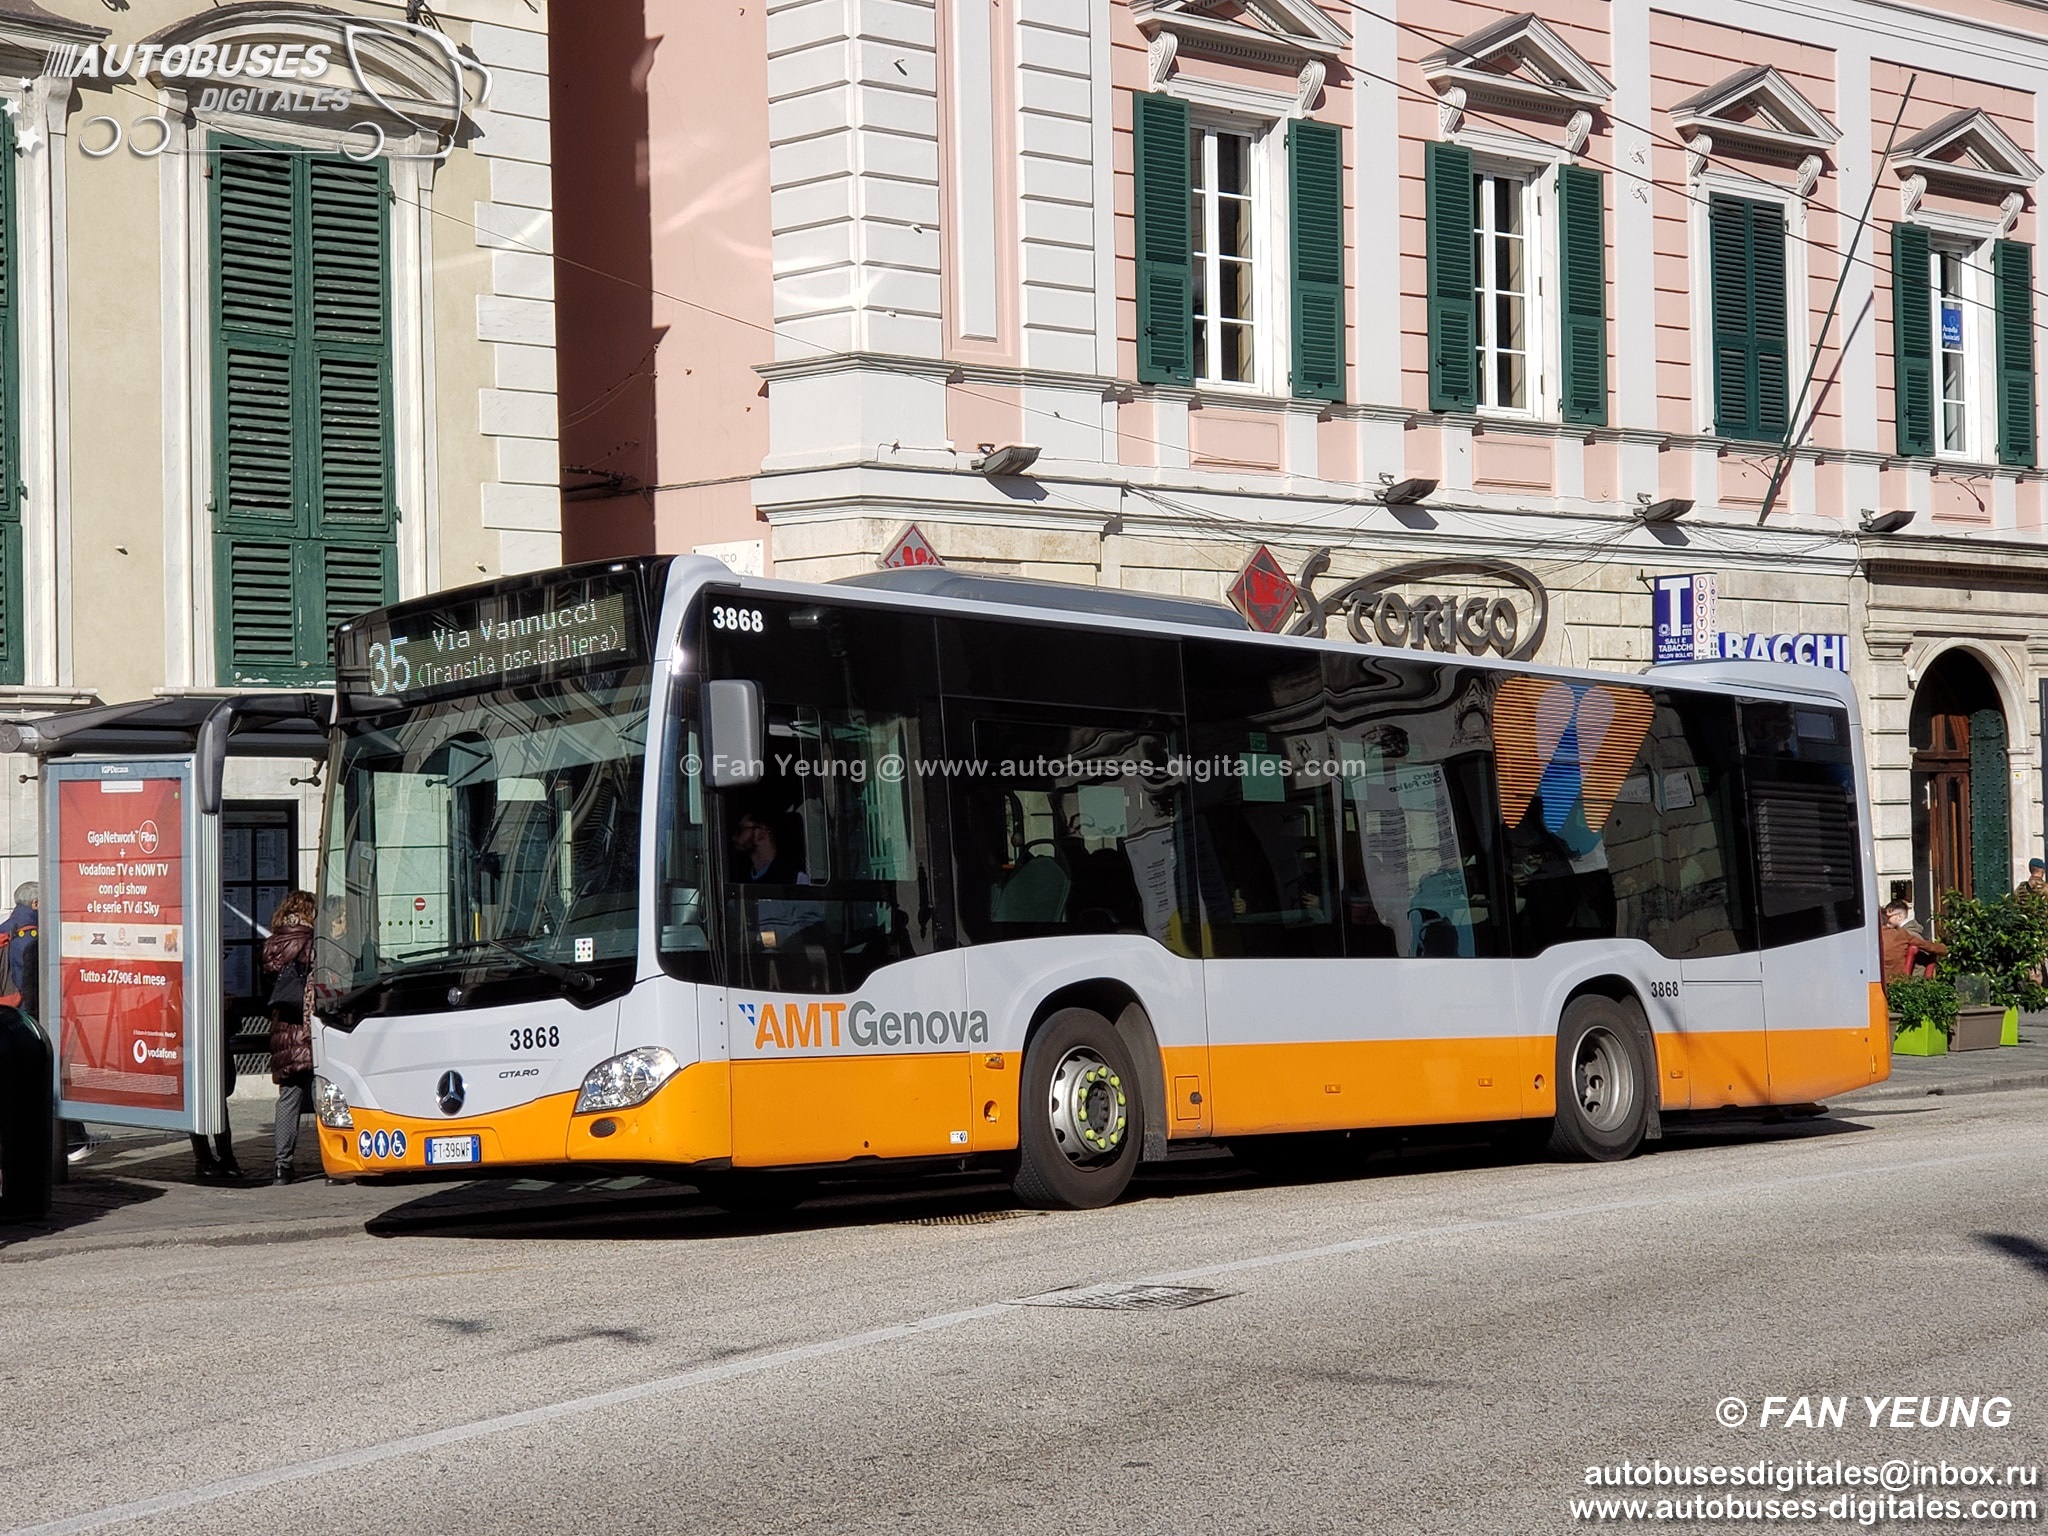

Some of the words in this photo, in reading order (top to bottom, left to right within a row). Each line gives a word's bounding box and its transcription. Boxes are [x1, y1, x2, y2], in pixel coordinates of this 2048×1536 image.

[715, 553, 737, 563] ICO
[432, 629, 470, 652] Via
[480, 599, 597, 641] Vannucci
[712, 606, 764, 632] 3868
[369, 636, 410, 695] 35
[78, 863, 115, 876] Vodafone
[116, 863, 127, 875] TV
[135, 864, 156, 876] NOW
[156, 863, 169, 877] TV
[98, 884, 113, 895] con
[114, 882, 124, 898] gli
[126, 882, 148, 895] show
[93, 900, 101, 913] le
[102, 900, 122, 913] serie
[122, 901, 134, 914] TV
[134, 901, 142, 914] di
[143, 901, 160, 917] Sky
[80, 969, 100, 983] Tutto
[107, 969, 133, 985] 27,90€
[133, 972, 142, 985] al
[142, 975, 167, 986] mese
[1651, 981, 1679, 998] 3868
[509, 1025, 560, 1051] 3868
[147, 1048, 177, 1059] vodafone
[498, 1068, 539, 1079] CITARO
